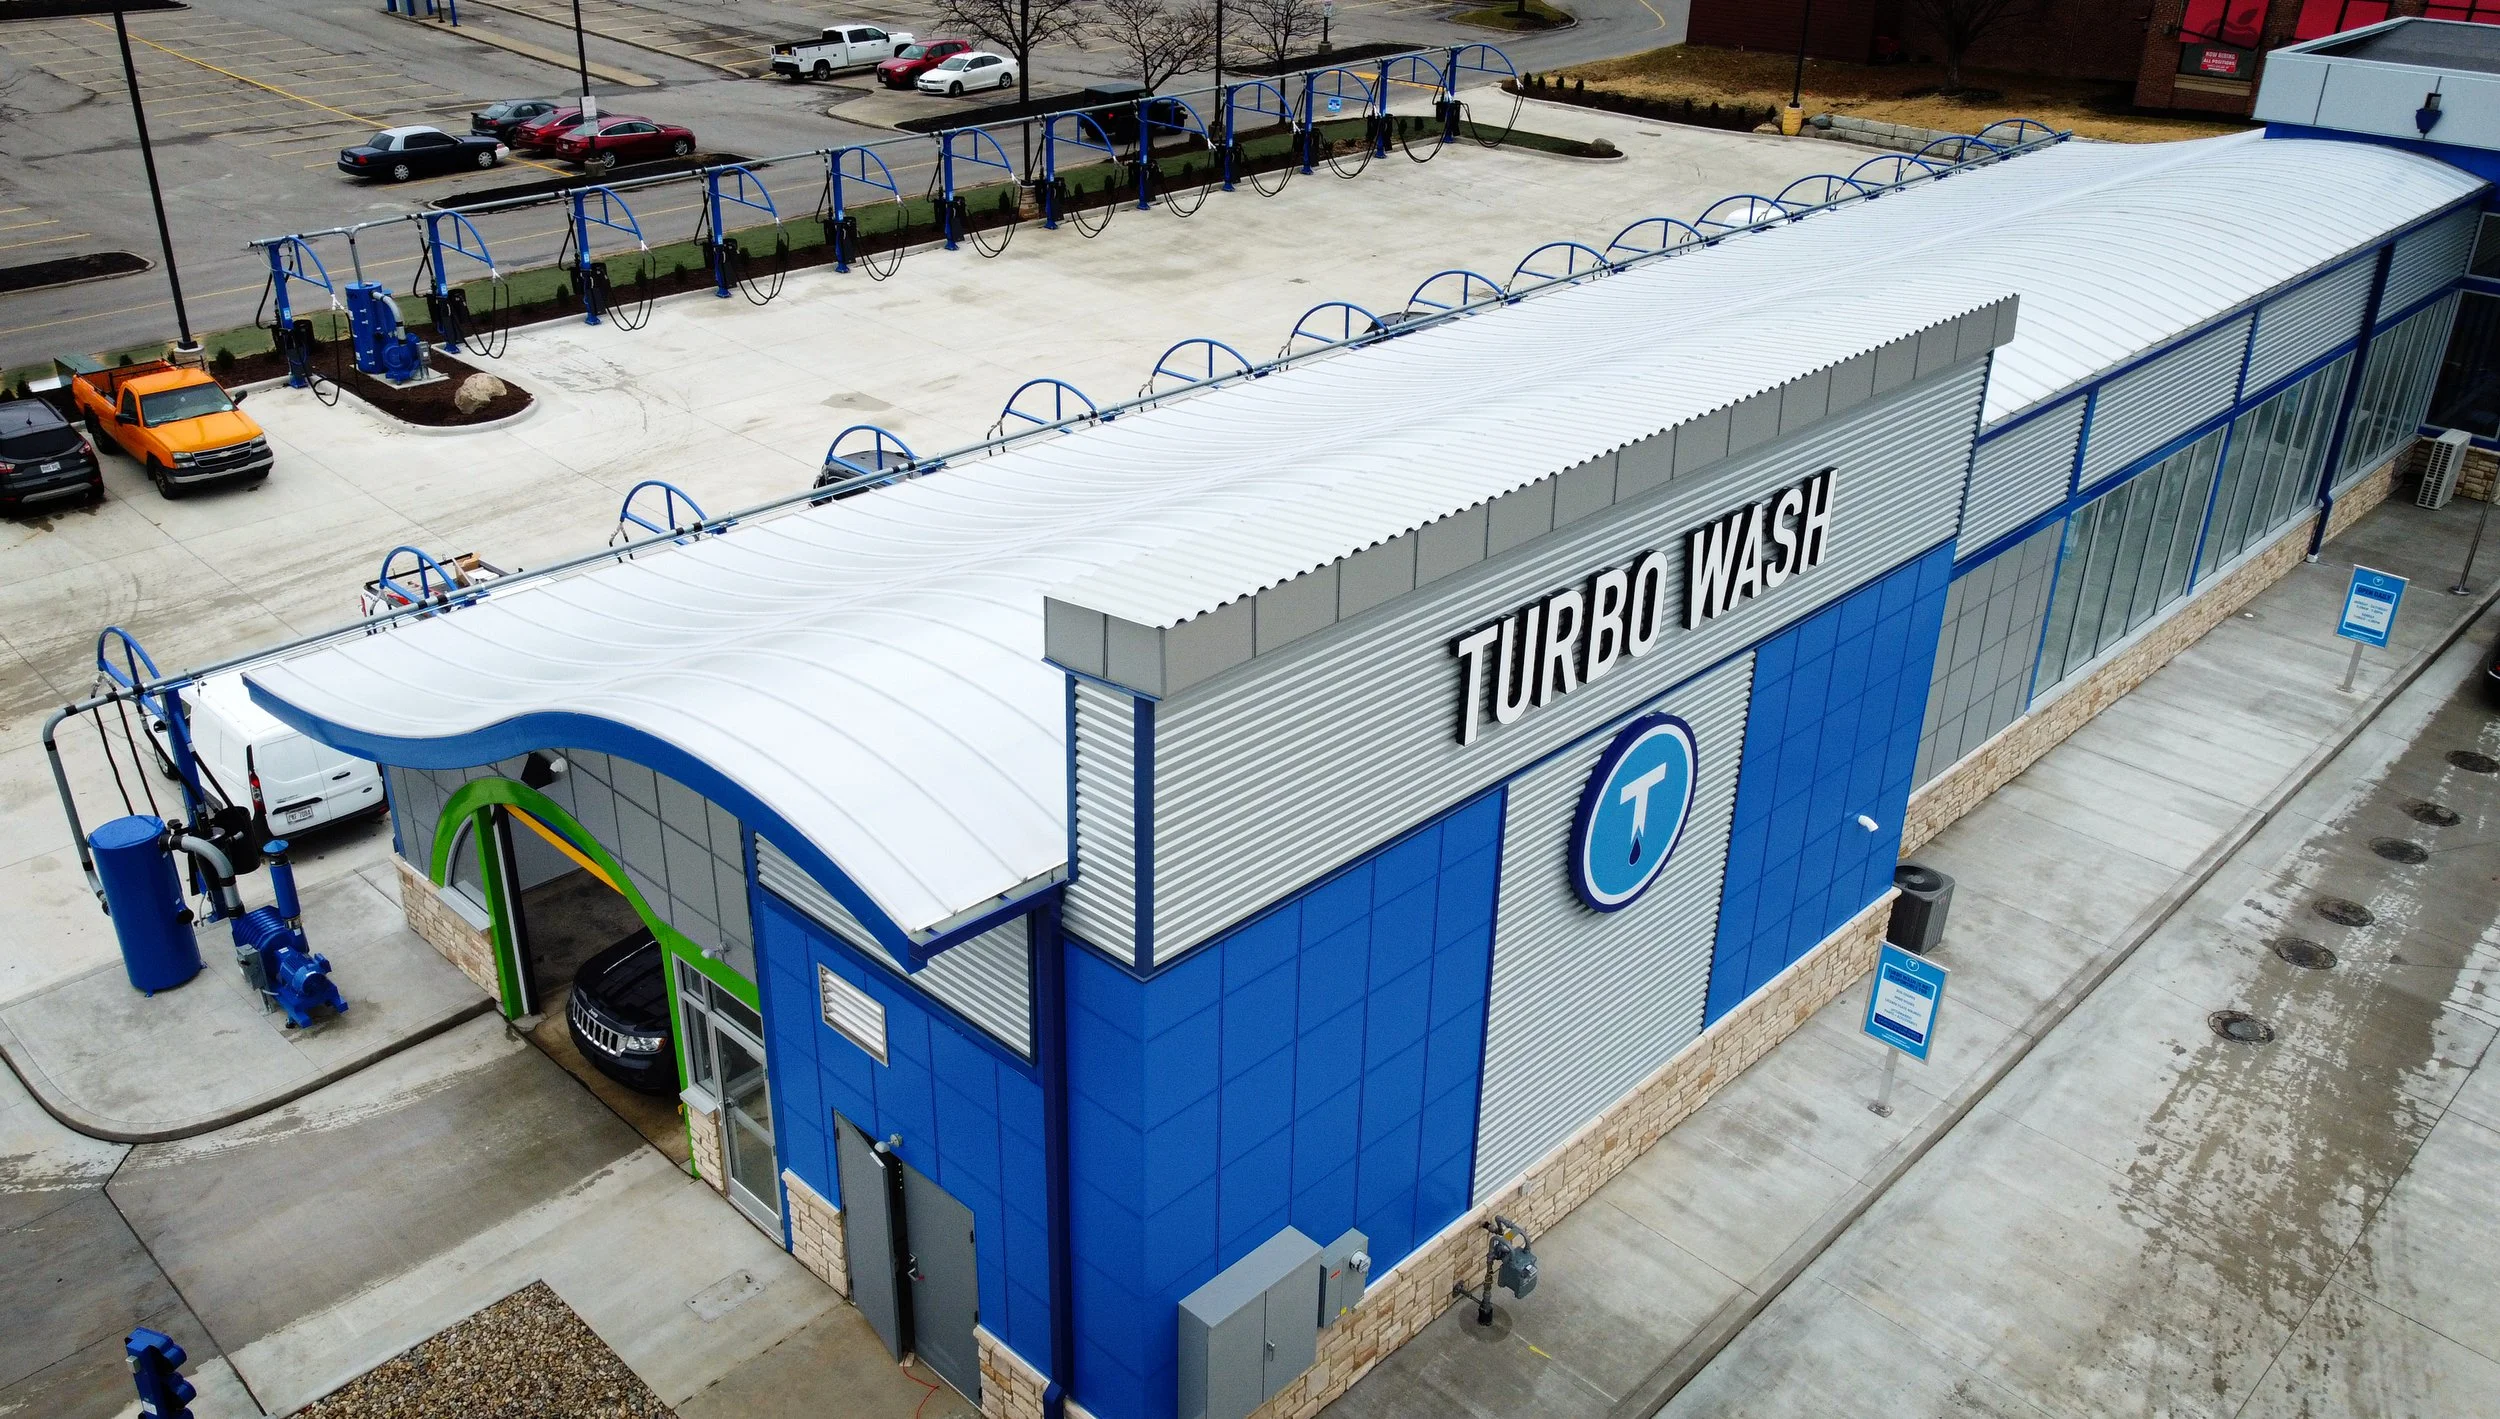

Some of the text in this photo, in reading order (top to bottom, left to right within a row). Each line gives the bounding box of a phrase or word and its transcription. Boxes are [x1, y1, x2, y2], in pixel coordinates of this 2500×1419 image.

[1453, 467, 1839, 747] TURBO WASH
[2358, 586, 2391, 600] OPEN DAILY
[1619, 761, 1668, 841] T
